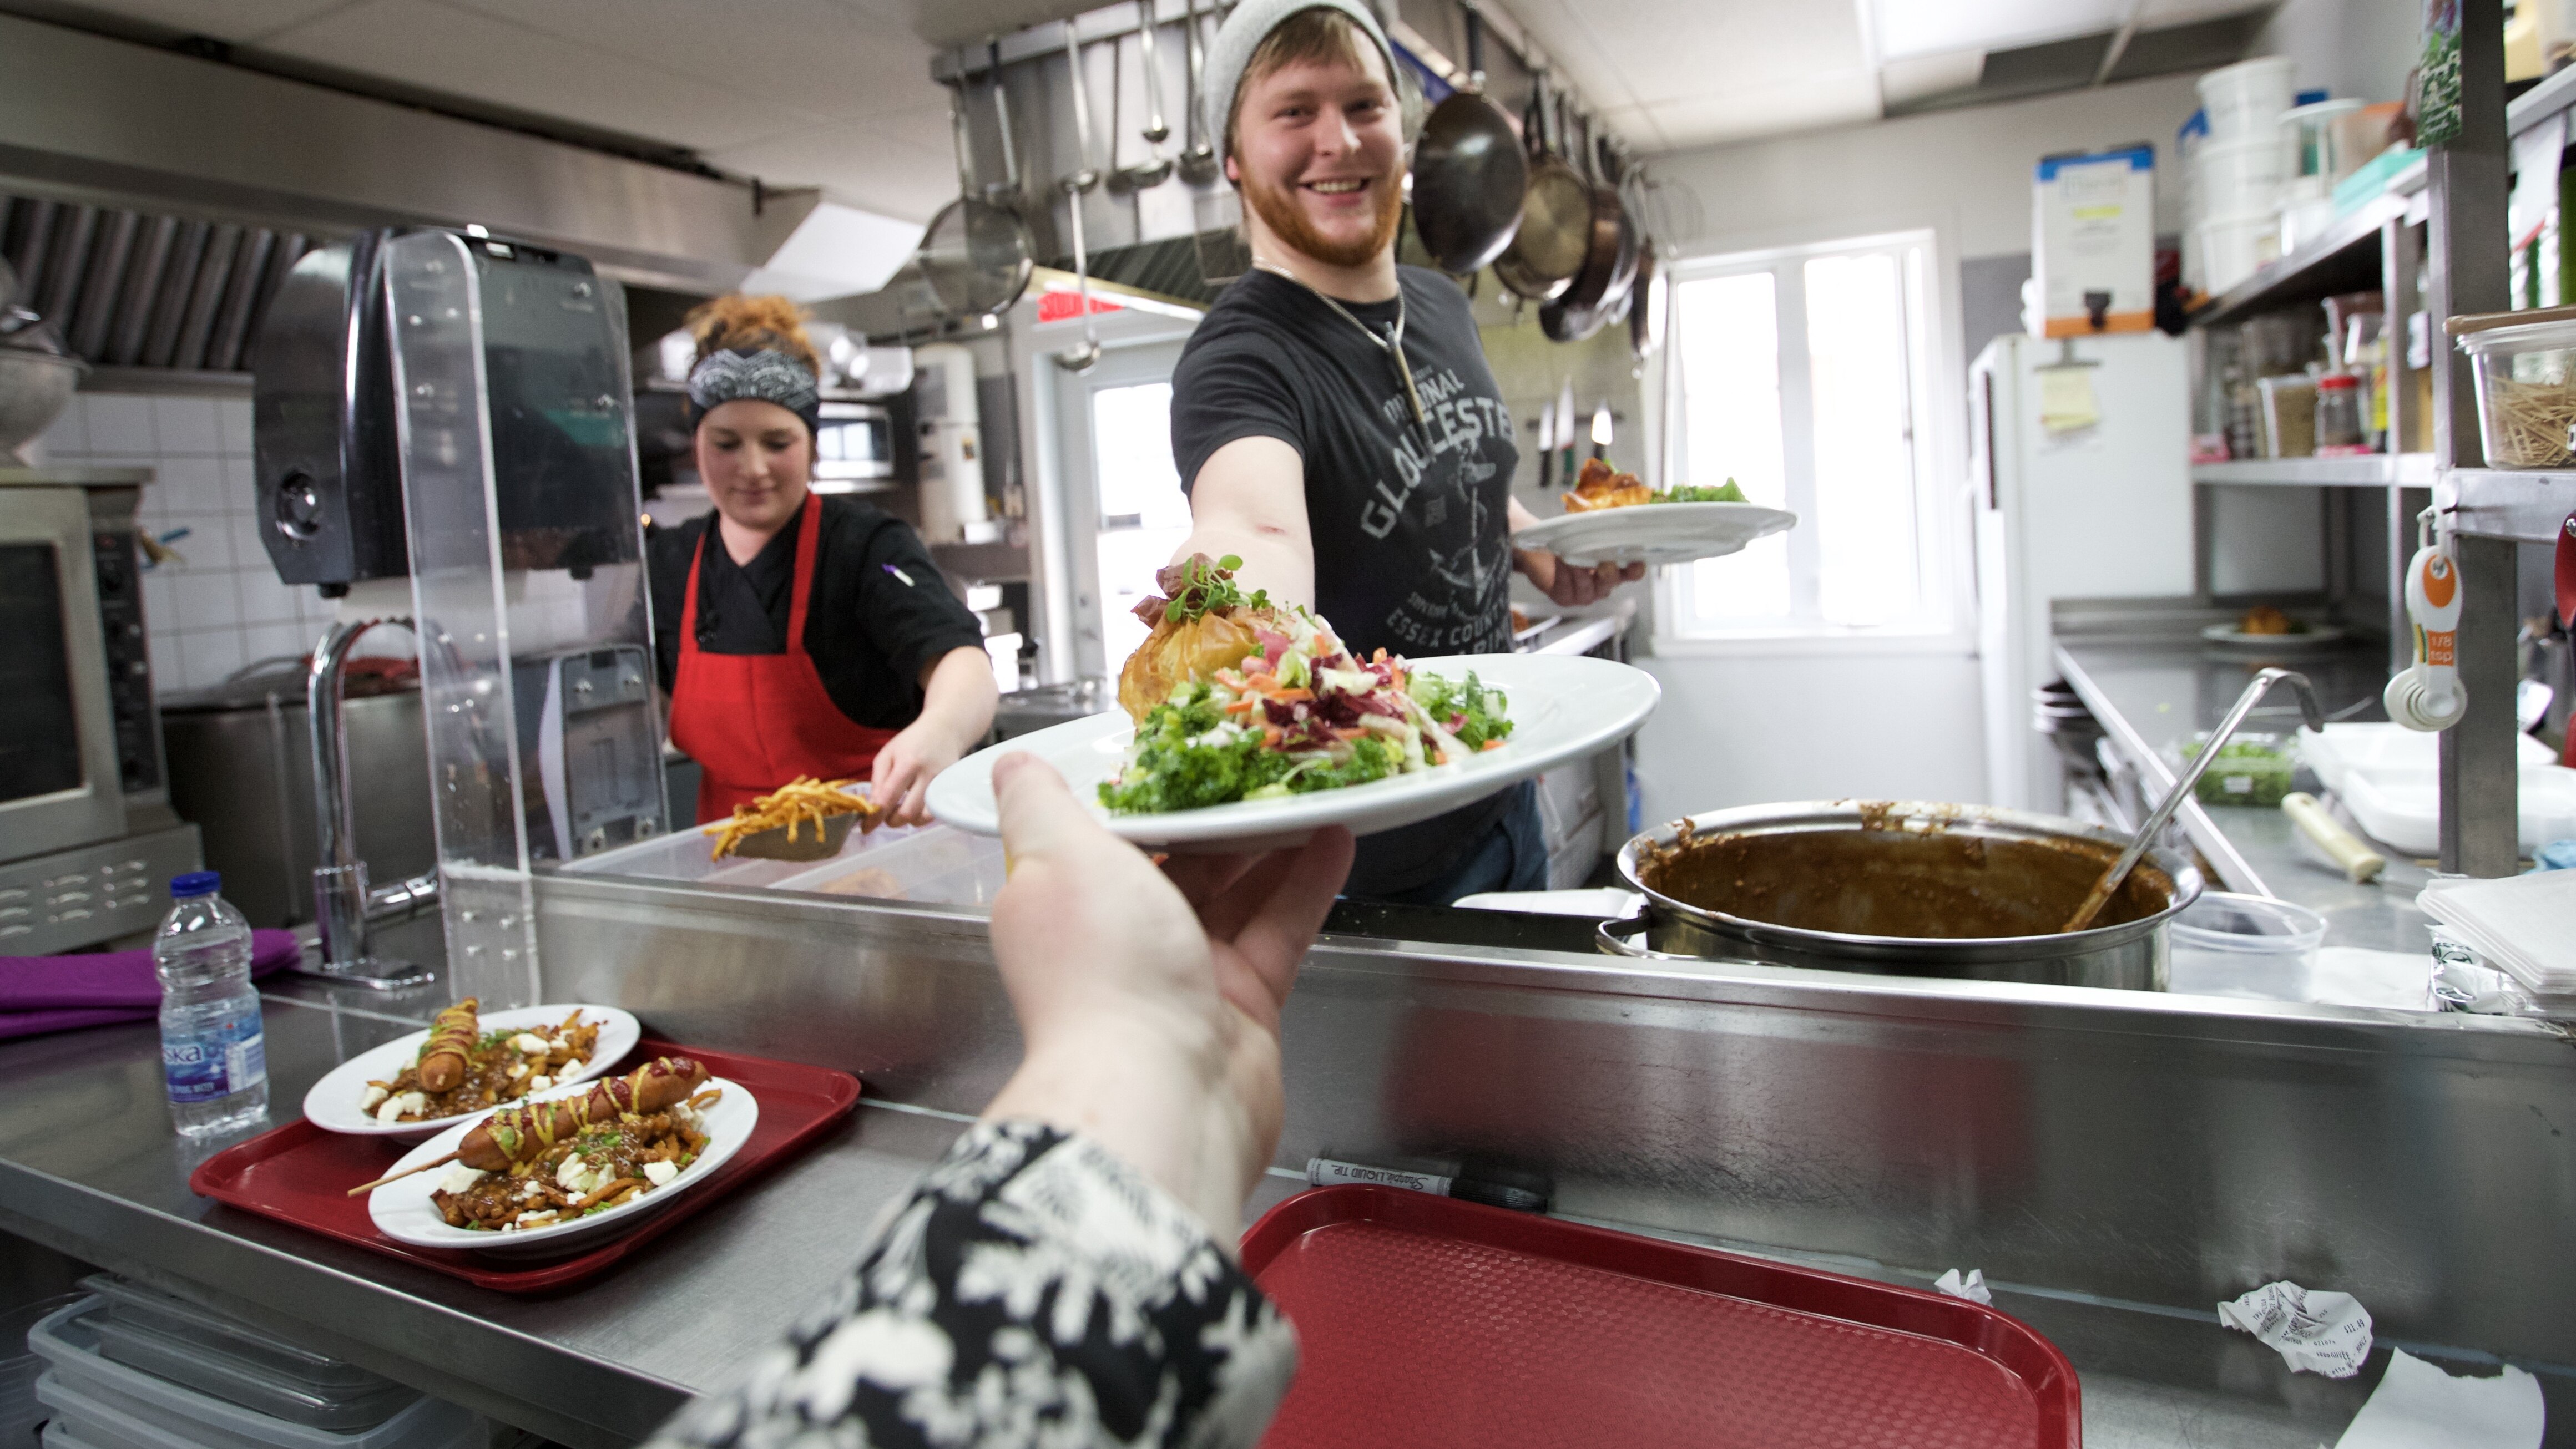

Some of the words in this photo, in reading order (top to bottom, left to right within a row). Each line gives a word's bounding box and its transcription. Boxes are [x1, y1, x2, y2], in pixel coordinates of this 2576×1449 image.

[2432, 636, 2452, 647] 1/8
[1351, 1168, 1384, 1181] LIQUID
[1387, 1172, 1429, 1190] Sharpie
[2344, 1319, 2365, 1334] $11.49
